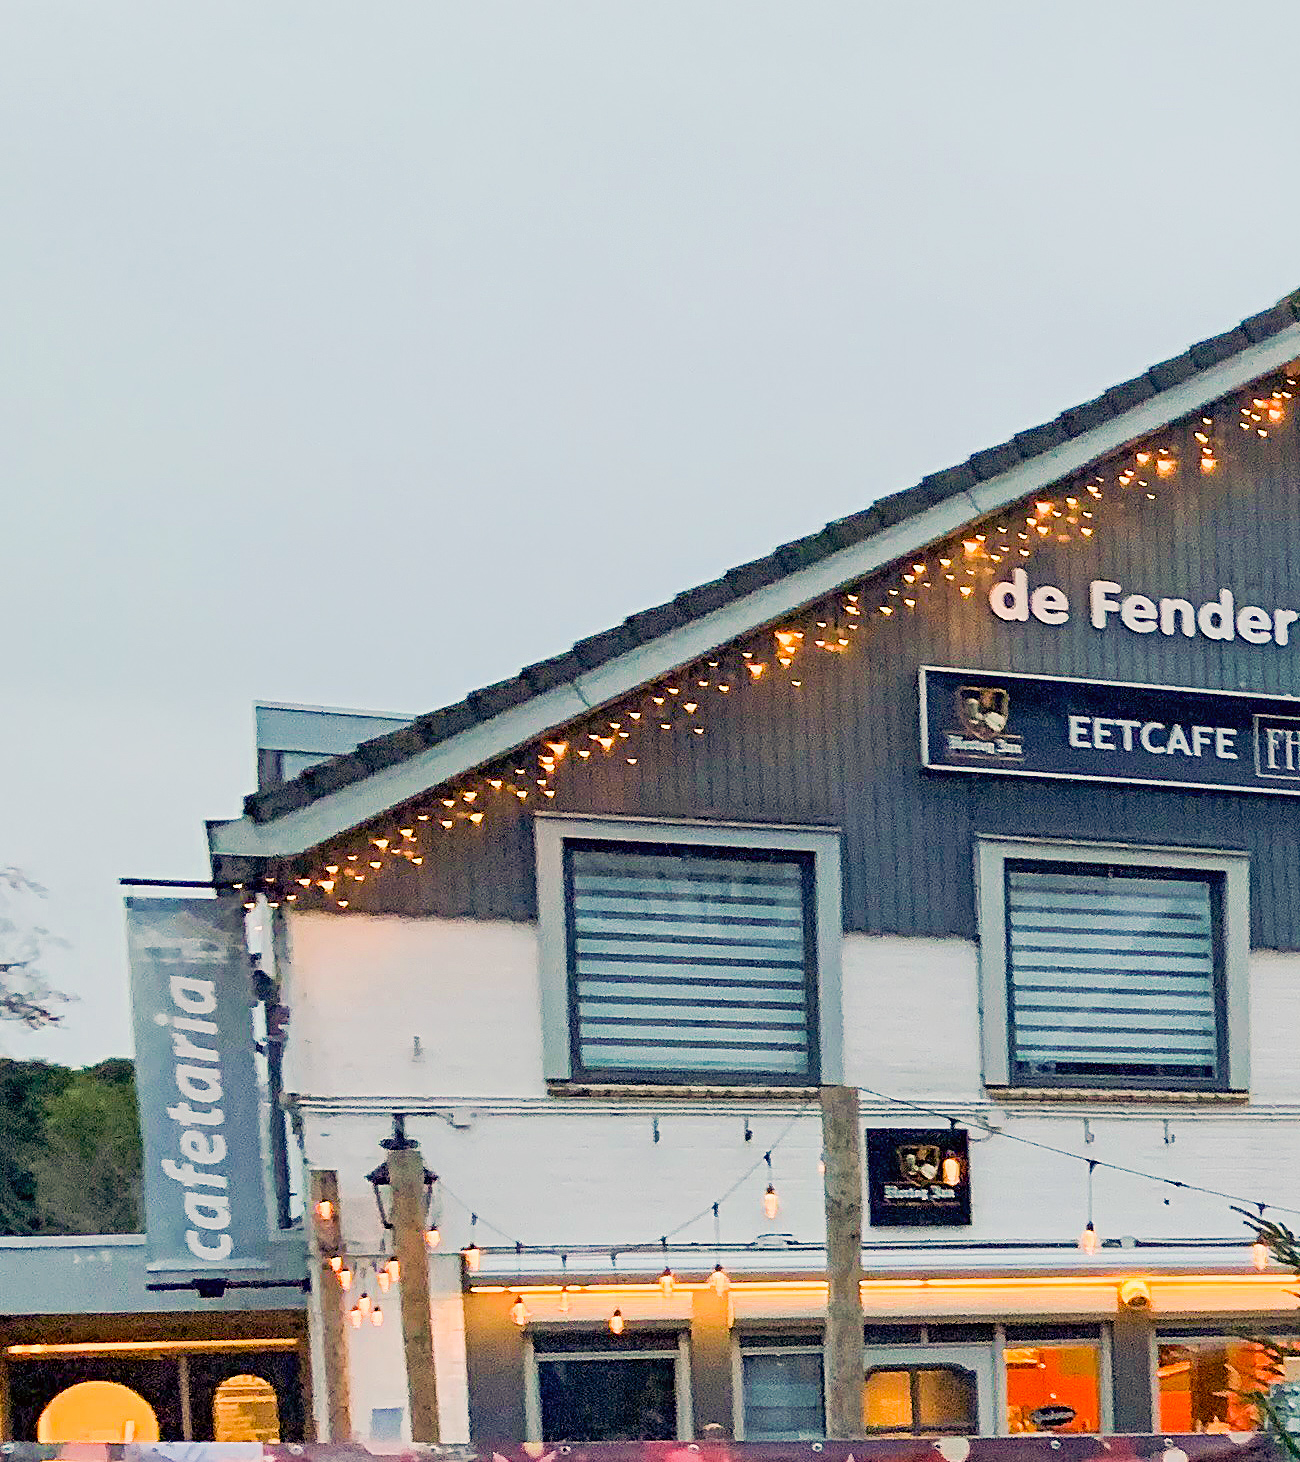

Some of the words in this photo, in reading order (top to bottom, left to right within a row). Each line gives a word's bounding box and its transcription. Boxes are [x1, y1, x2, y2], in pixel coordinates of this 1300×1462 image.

[989, 567, 1070, 625] de
[1068, 714, 1239, 761] EETCAFE
[153, 974, 235, 1263] cafetaria
